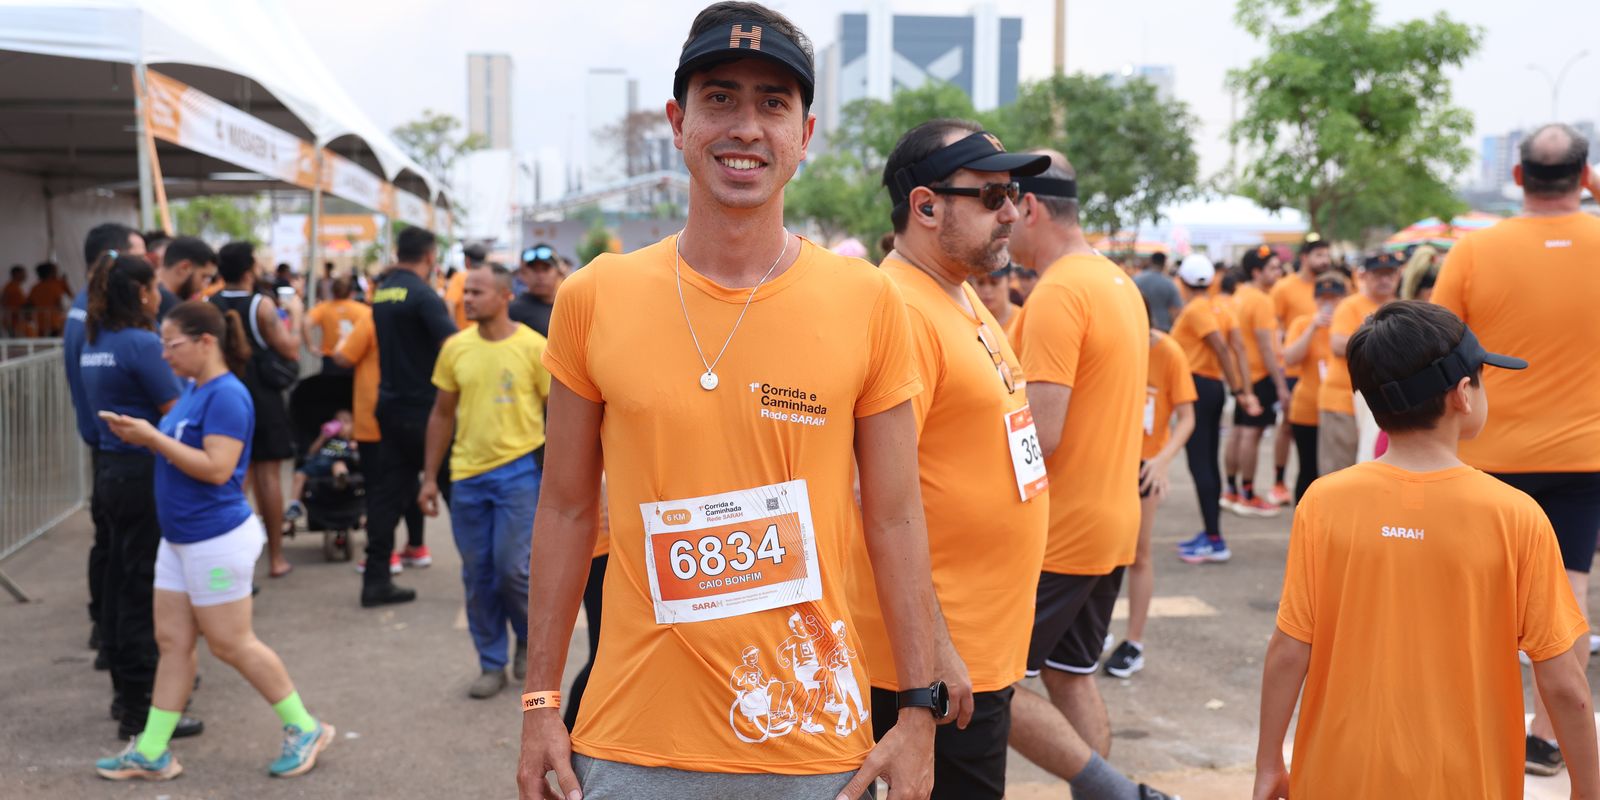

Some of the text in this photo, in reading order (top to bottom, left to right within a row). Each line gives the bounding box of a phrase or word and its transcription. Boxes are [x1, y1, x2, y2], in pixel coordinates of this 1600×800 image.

[730, 24, 761, 50] H
[761, 383, 806, 400] Corrida
[810, 393, 817, 401] e
[761, 395, 827, 415] Caminhada
[761, 408, 826, 426] Rede SARAH
[704, 502, 729, 511] Corrida
[705, 506, 742, 517] Caminhada
[667, 513, 686, 522] 6 KM
[707, 512, 744, 523] Rede SARAH
[1381, 526, 1424, 540] SARAH
[669, 524, 786, 580] 6834
[699, 571, 762, 590] CAIO BONFIM
[692, 601, 723, 611] SARAH
